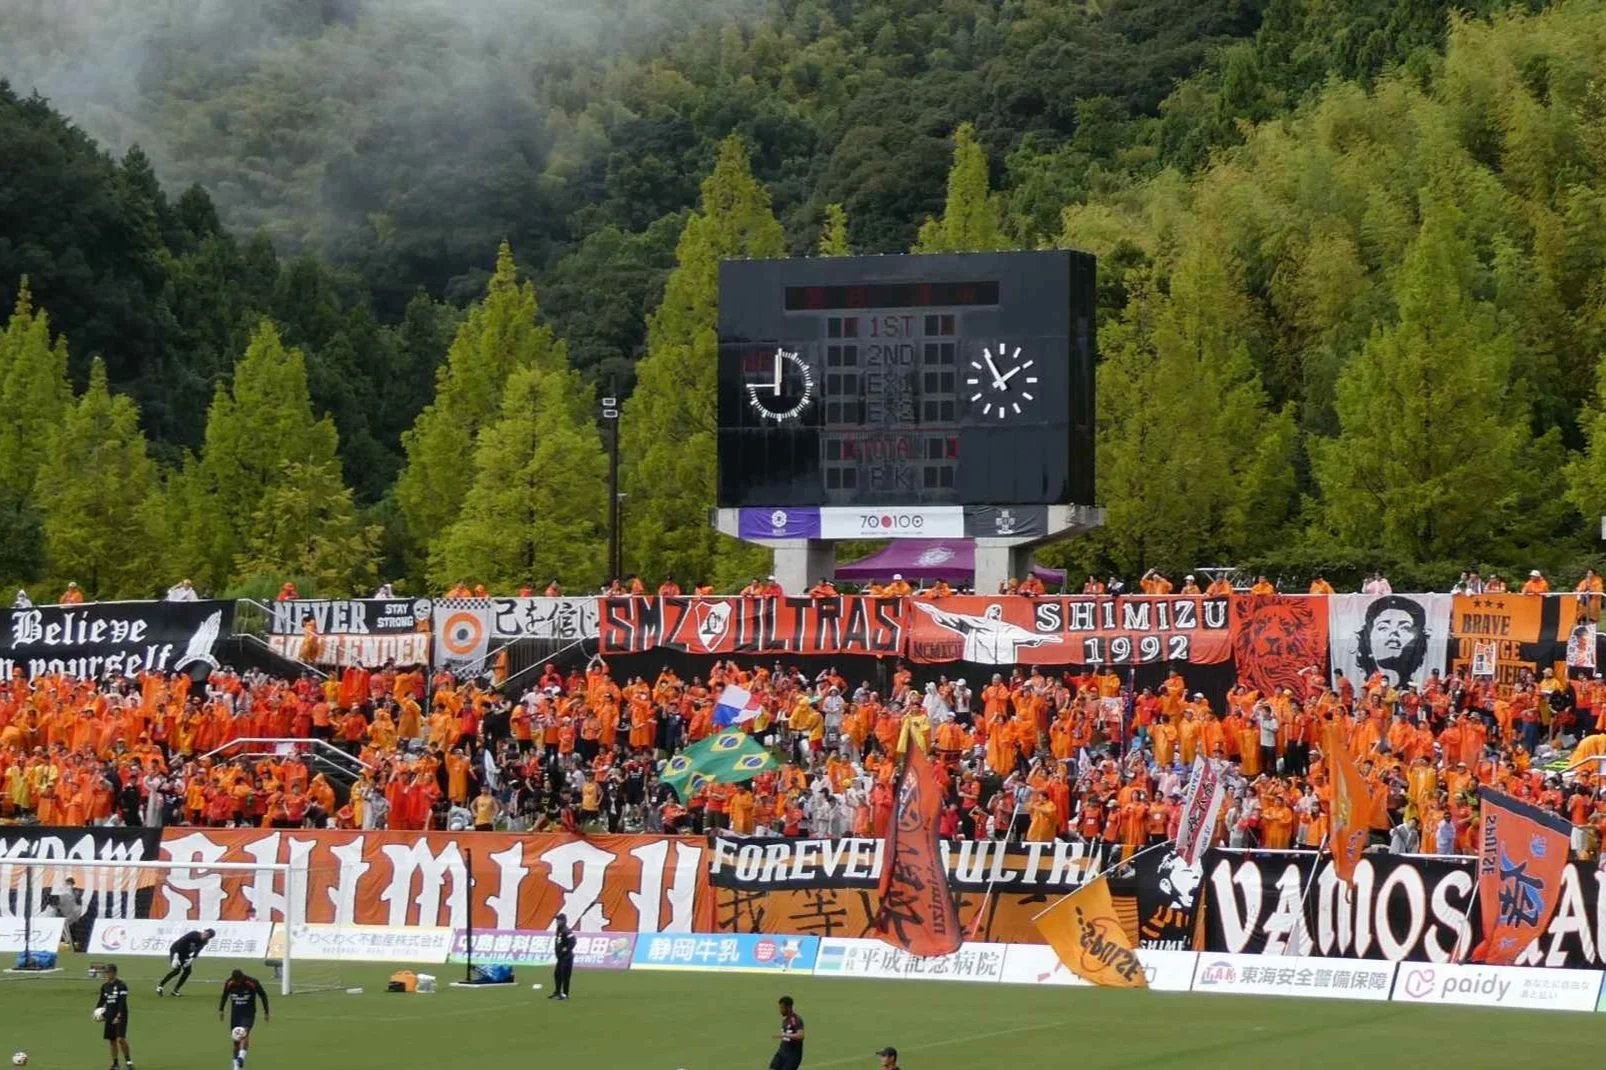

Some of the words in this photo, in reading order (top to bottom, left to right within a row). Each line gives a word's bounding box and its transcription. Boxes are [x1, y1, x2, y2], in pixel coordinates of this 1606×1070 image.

[869, 315, 915, 337] 1ST
[868, 344, 914, 366] 2ND
[272, 601, 370, 634] NEVER
[377, 616, 413, 628] STRONG
[385, 603, 409, 615] STAY
[495, 599, 599, 637] 己を信じ
[1035, 600, 1228, 631] SHIMIZU
[11, 609, 148, 650] Believe
[605, 597, 692, 652] SMZ
[734, 597, 902, 652] ULTRAS
[1462, 613, 1512, 635] BRAVE
[1083, 636, 1190, 663] 1992
[27, 644, 173, 690] yourself
[161, 831, 702, 934] SHIMIZU
[1210, 858, 1475, 962] VAMOS
[648, 937, 741, 963] 静岡牛乳
[1240, 965, 1388, 991] 東海安全警備保障
[1441, 972, 1512, 1001] paidy
